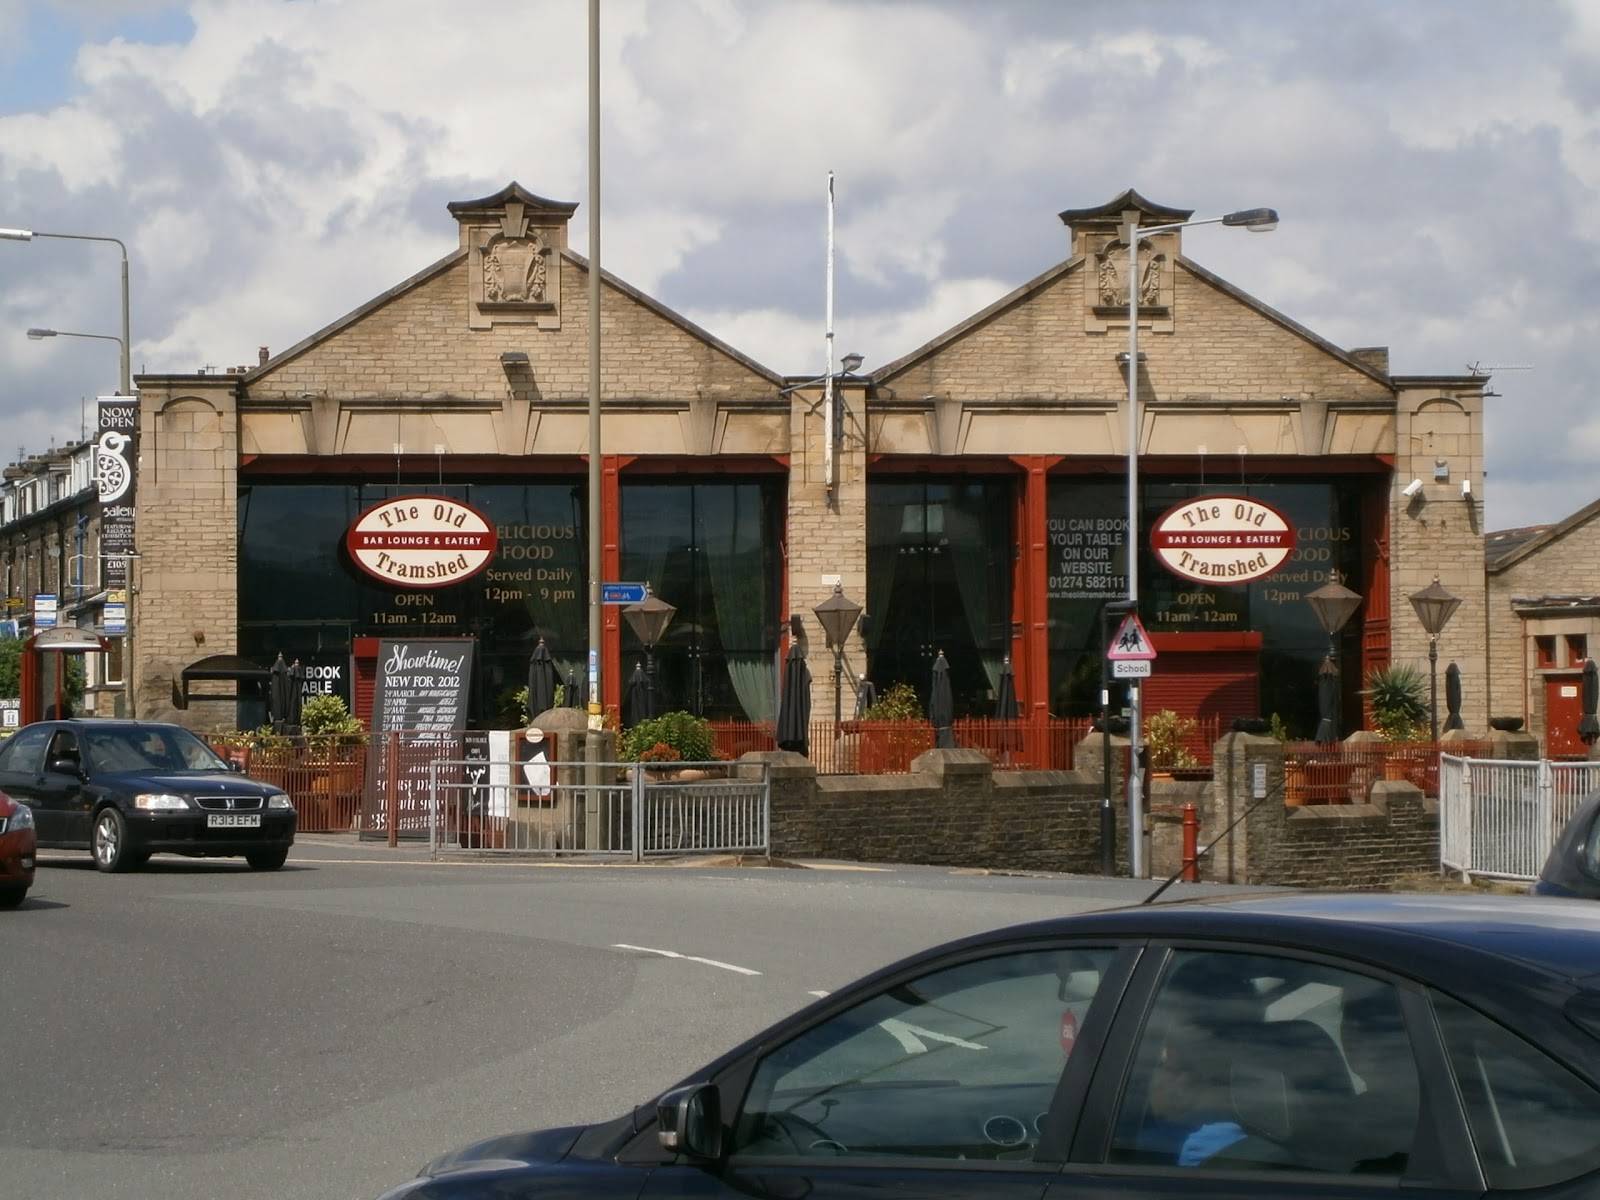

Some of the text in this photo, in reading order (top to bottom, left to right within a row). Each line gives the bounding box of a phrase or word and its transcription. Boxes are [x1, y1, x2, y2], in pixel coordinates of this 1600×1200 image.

[101, 407, 134, 417] NOW
[100, 417, 134, 427] OPEN
[379, 504, 467, 528] The Old
[1182, 503, 1267, 527] The Old
[1069, 519, 1094, 531] CAN
[1096, 519, 1130, 531] BOOK
[496, 525, 574, 539] ELICIOUS
[1297, 527, 1350, 541] CIOUS
[1051, 533, 1122, 545] YOUR TABLE
[1168, 536, 1187, 544] BAR
[1247, 535, 1281, 543] EATERY
[503, 546, 554, 559] FOOD
[1063, 547, 1109, 560] ON OUR
[1291, 547, 1331, 562] OOD
[376, 552, 469, 578] Tramshed
[1061, 562, 1112, 574] WEBSITE
[1179, 550, 1268, 577] Tramshed
[486, 568, 573, 584] Served Daily
[1049, 576, 1125, 588] 01274 582111
[1313, 569, 1348, 586] Daly
[394, 594, 434, 606] OPEN
[484, 588, 522, 603] 12pm
[540, 588, 549, 599] 9
[554, 590, 575, 603] pm
[1178, 593, 1216, 605] OPEN
[1263, 589, 1299, 604] 12pm
[373, 612, 408, 624] 11am
[421, 612, 456, 624] 12am
[1156, 611, 1191, 622] 11am
[1203, 611, 1238, 622] 12am
[384, 644, 465, 675] Showtime!
[305, 666, 341, 679] BOOK
[1117, 664, 1148, 673] School
[301, 681, 333, 694] ABLE
[385, 676, 460, 687] NEW FOR 2012
[211, 815, 258, 826] R313 EFM
